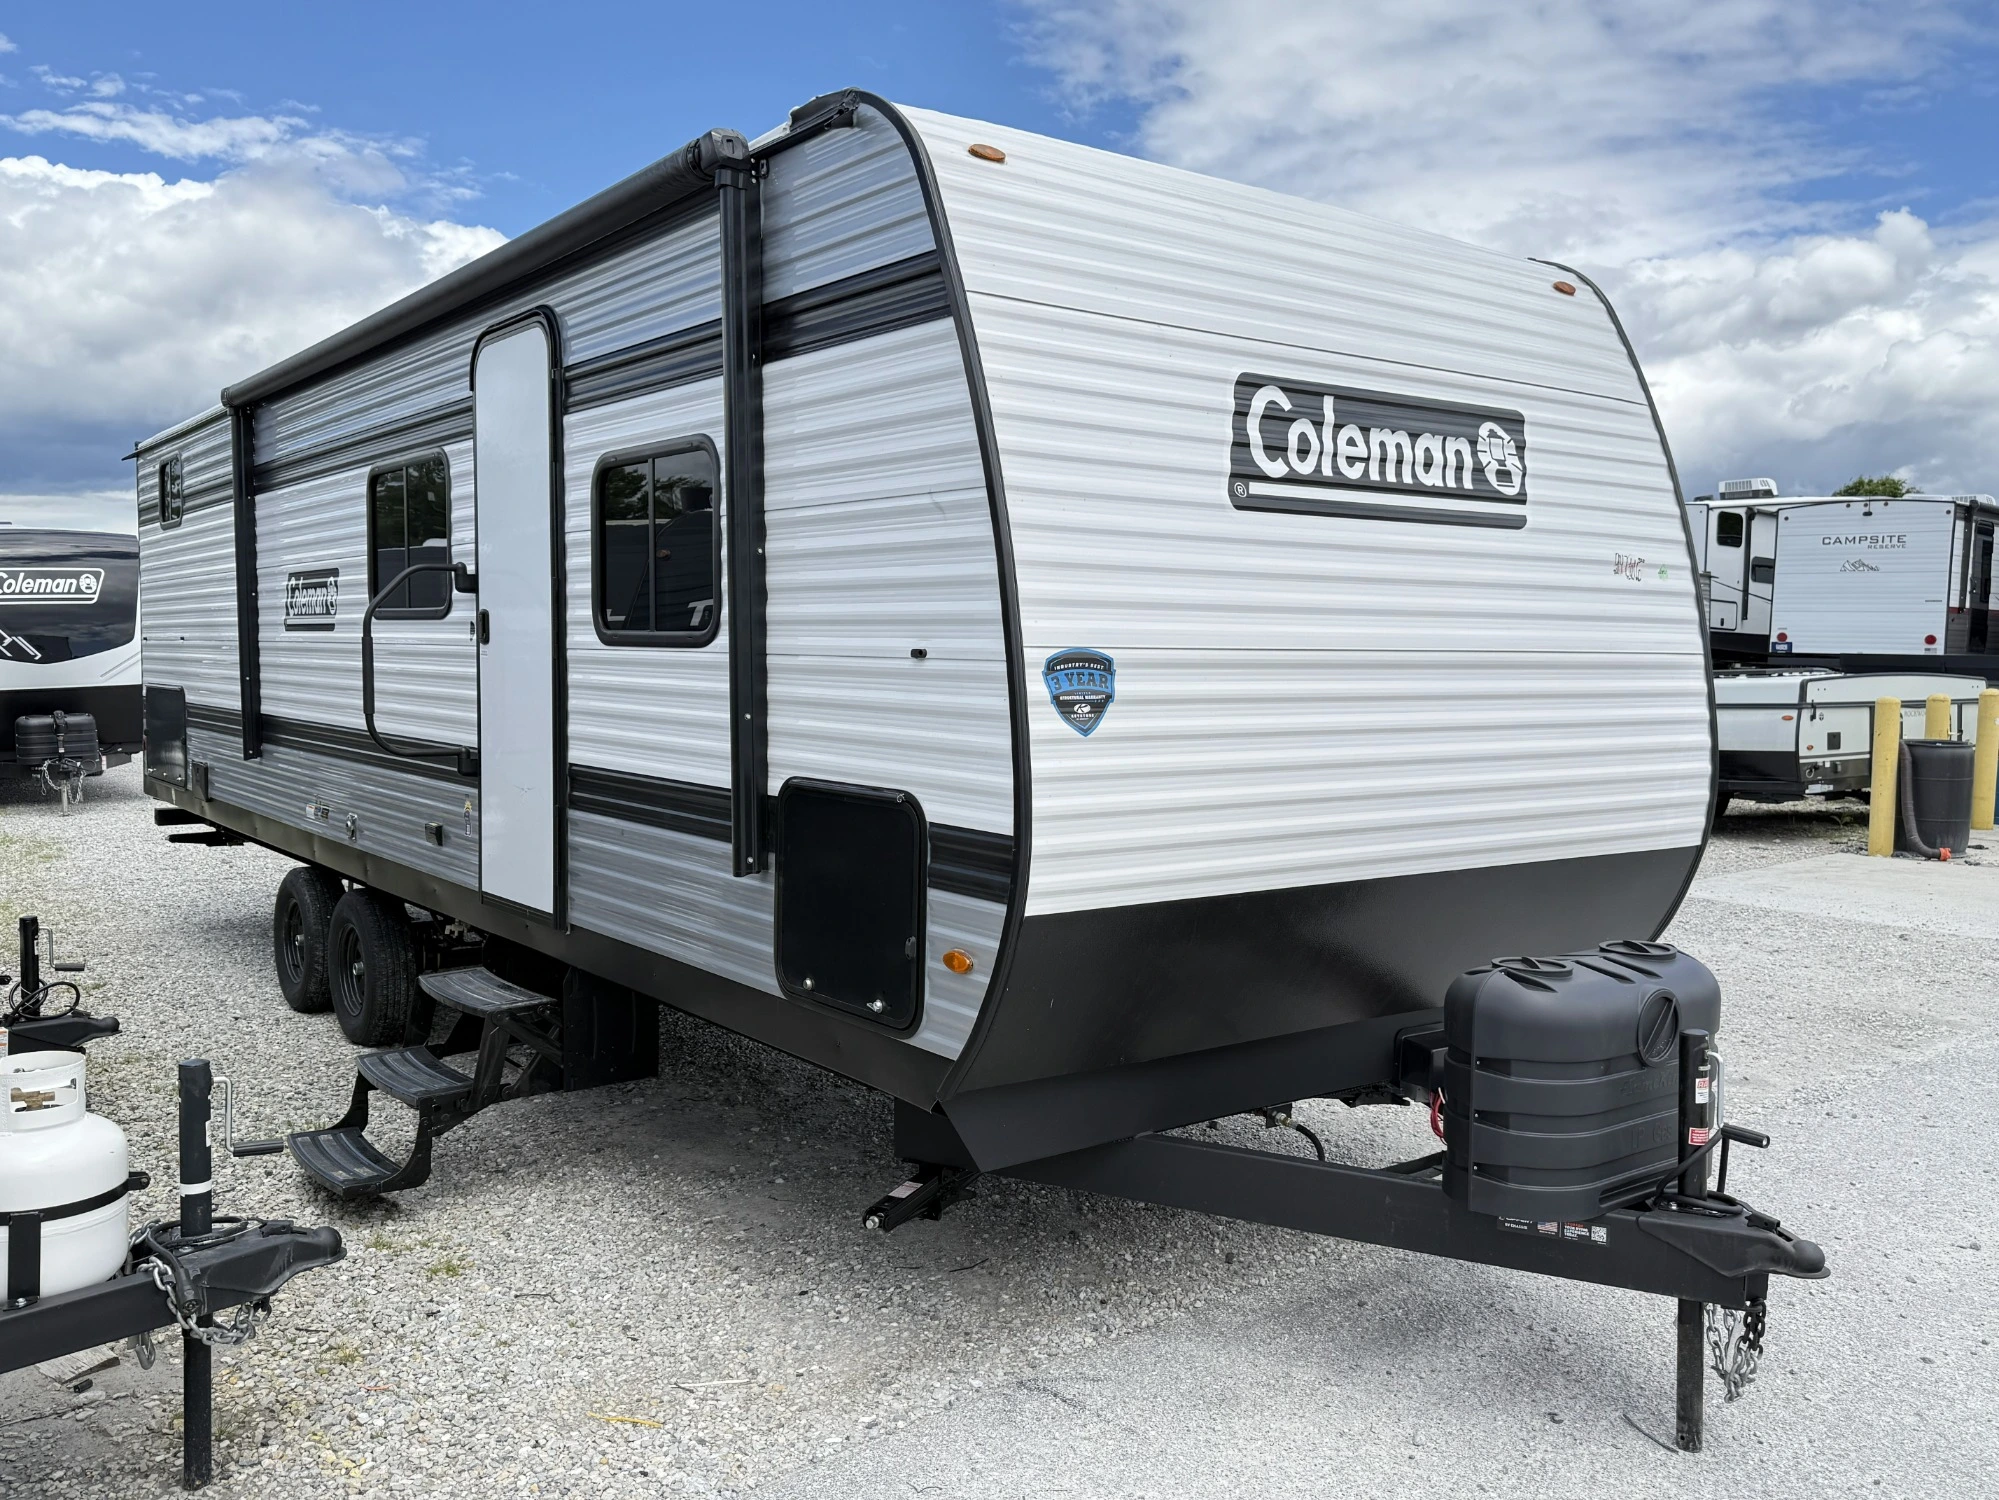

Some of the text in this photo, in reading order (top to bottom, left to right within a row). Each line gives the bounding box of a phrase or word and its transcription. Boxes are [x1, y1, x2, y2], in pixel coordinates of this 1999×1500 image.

[1246, 385, 1474, 490] Coleman
[1821, 534, 1907, 546] CAMPSITE
[287, 576, 328, 618] Coleman
[1051, 672, 1109, 690] 3 YEAR
